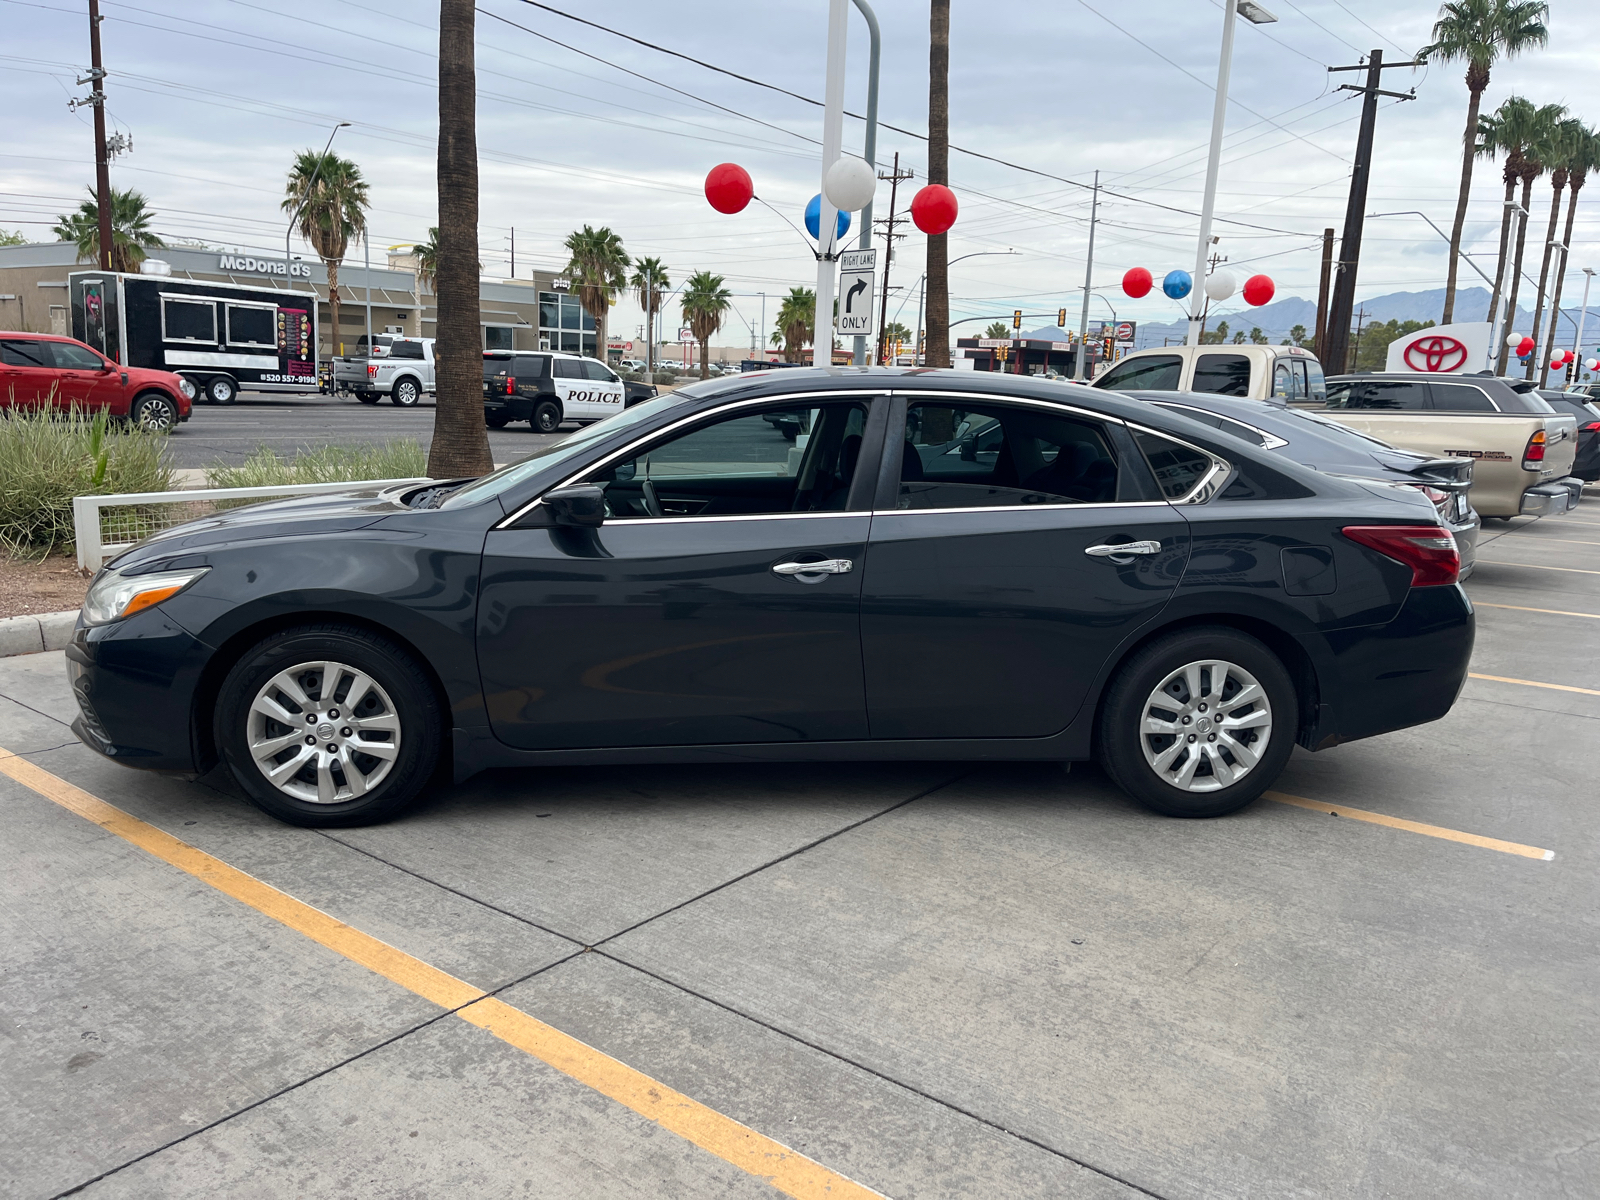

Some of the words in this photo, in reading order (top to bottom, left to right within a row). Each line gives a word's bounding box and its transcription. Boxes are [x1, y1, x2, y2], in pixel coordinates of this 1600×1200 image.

[219, 255, 312, 277] McDonad's
[843, 255, 859, 266] RIGHT
[860, 254, 874, 265] LANE
[842, 316, 868, 329] ONLY
[266, 373, 281, 382] 520
[281, 374, 316, 384] 557-9198
[567, 390, 622, 404] POLICE
[1443, 449, 1484, 458] TRD
